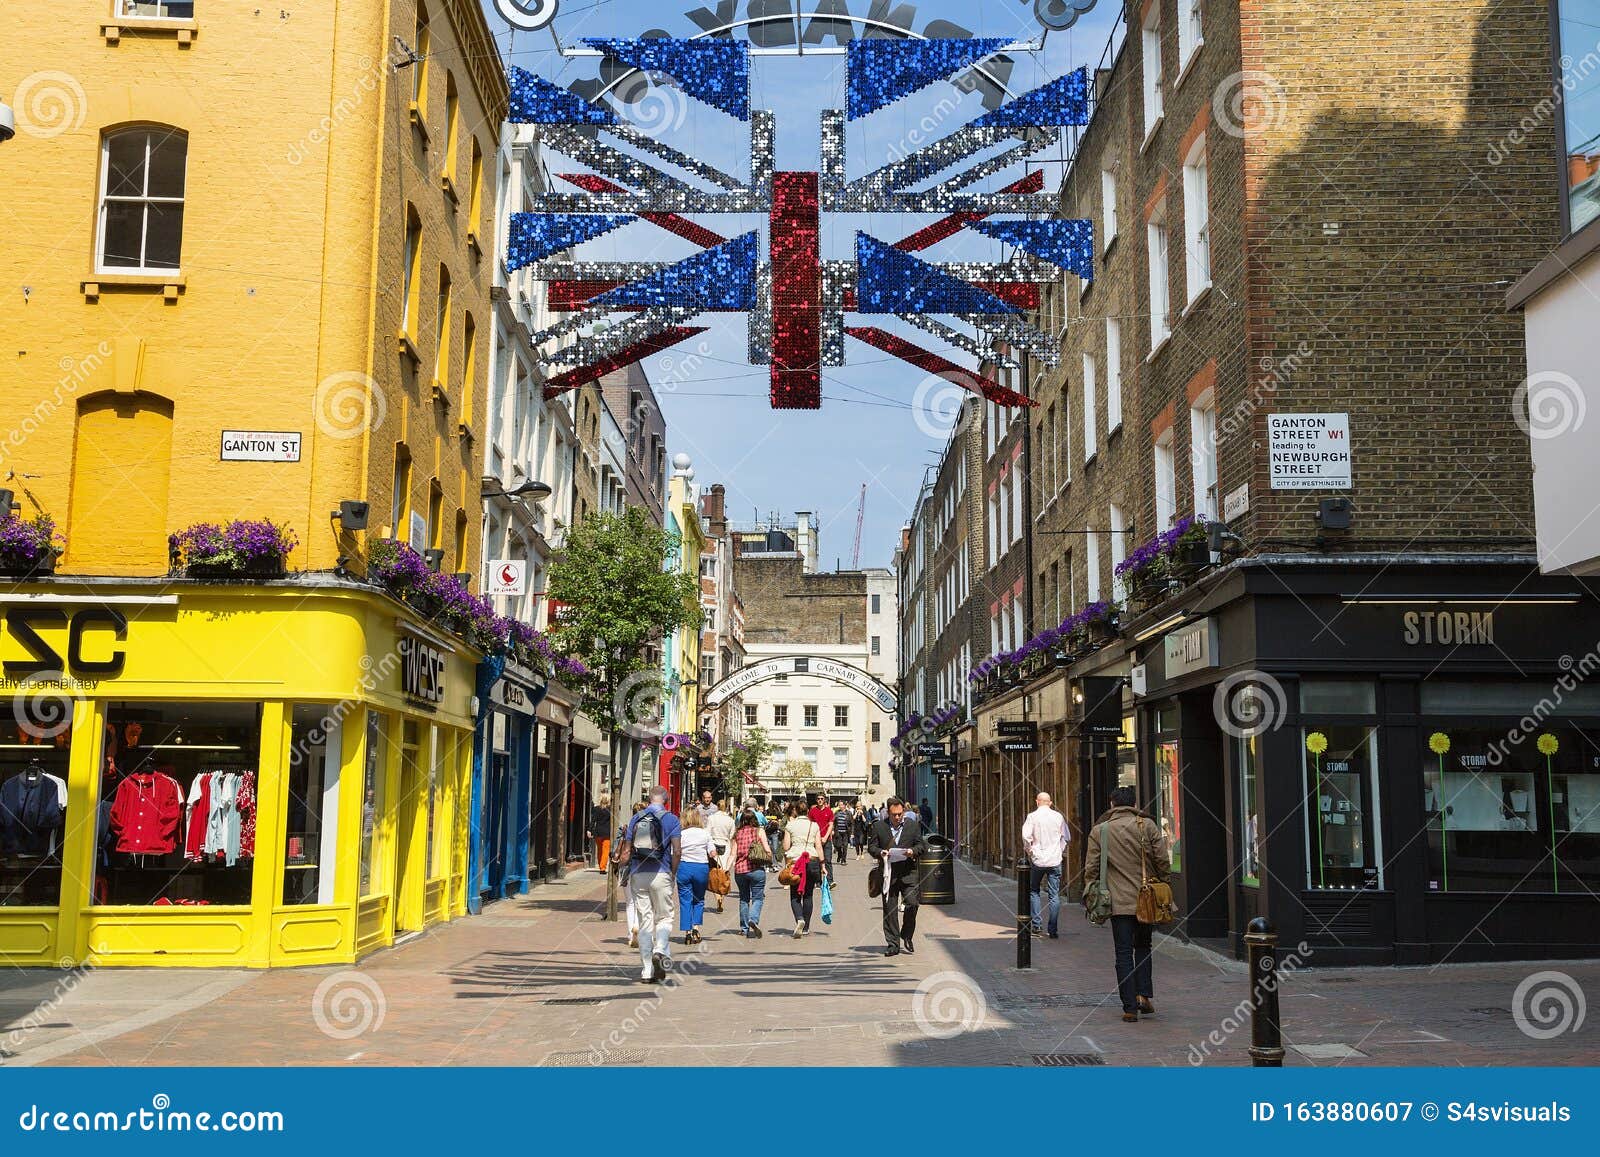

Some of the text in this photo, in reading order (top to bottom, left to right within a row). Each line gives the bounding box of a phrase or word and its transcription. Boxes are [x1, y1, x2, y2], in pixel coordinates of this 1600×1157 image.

[1272, 418, 1326, 428] GANTON
[1273, 430, 1344, 439] STREET W1
[224, 440, 275, 452] GANTON
[1272, 442, 1304, 450] leading
[1272, 452, 1348, 462] NEWBURGH
[1274, 464, 1322, 474] STREET
[1403, 611, 1494, 645] STORM
[719, 664, 779, 695] WELCOME TO
[816, 662, 891, 704] CARNABY STREET
[1460, 755, 1487, 766] STORM
[1326, 761, 1349, 772] STORM
